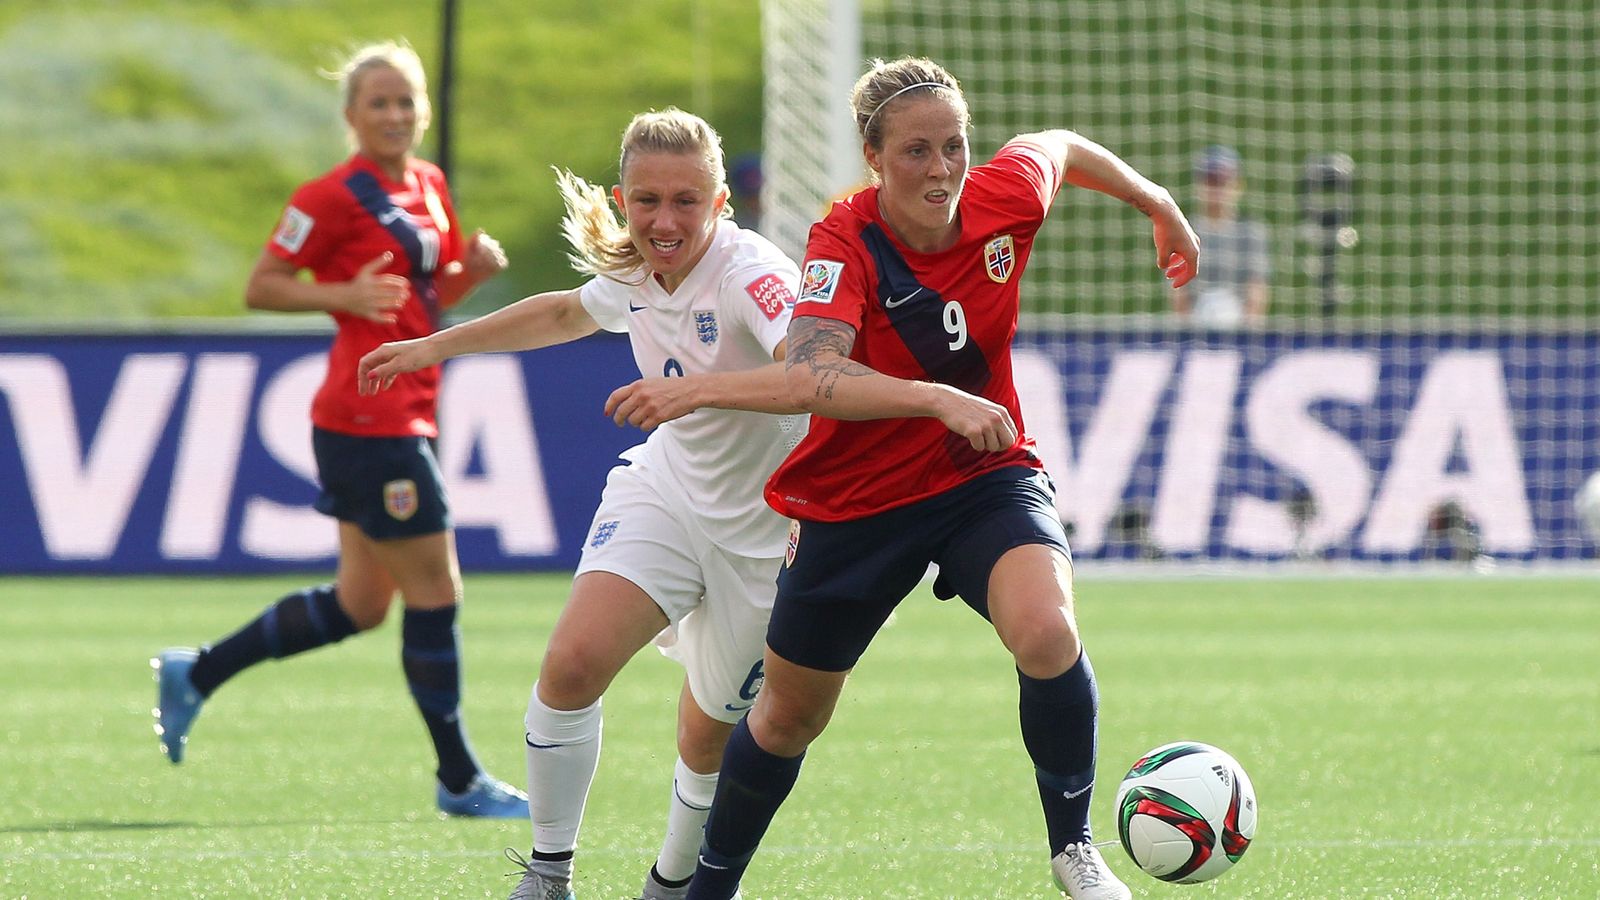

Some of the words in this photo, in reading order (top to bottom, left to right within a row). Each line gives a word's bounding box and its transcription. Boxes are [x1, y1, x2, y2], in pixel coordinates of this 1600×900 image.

[754, 278, 775, 298] LIVE
[759, 283, 786, 306] YOUR
[766, 290, 791, 314] GOALS
[943, 300, 967, 351] 9
[1010, 350, 1535, 553] VISA
[739, 658, 765, 700] 6
